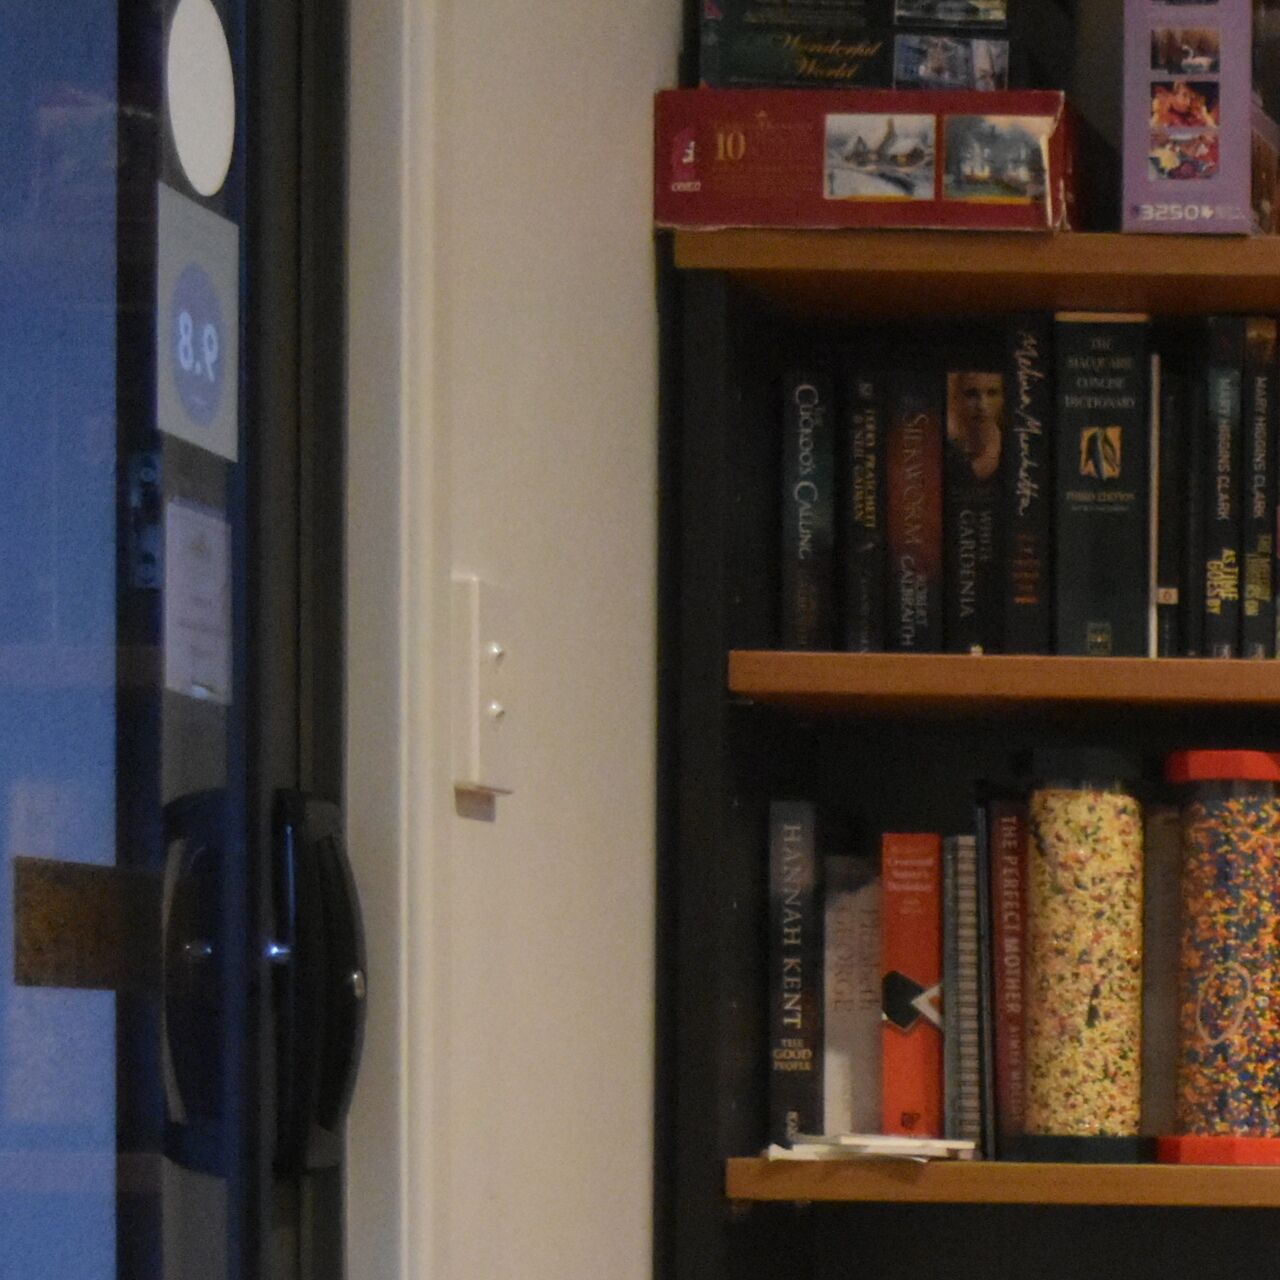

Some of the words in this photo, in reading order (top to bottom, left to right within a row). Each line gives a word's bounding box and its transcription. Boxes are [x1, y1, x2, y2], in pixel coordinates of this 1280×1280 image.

[715, 130, 745, 161] 10
[1140, 203, 1199, 222] 3250
[178, 310, 219, 384] 8.9
[1215, 475, 1229, 520] CLARK
[1251, 474, 1266, 519] CLARK
[958, 509, 975, 618] GARDENIA
[999, 815, 1016, 849] THE
[780, 824, 801, 951] HANNAH
[1001, 855, 1017, 932] PERFECT
[780, 957, 801, 1029] KENT
[1003, 937, 1020, 1015] MOTHER
